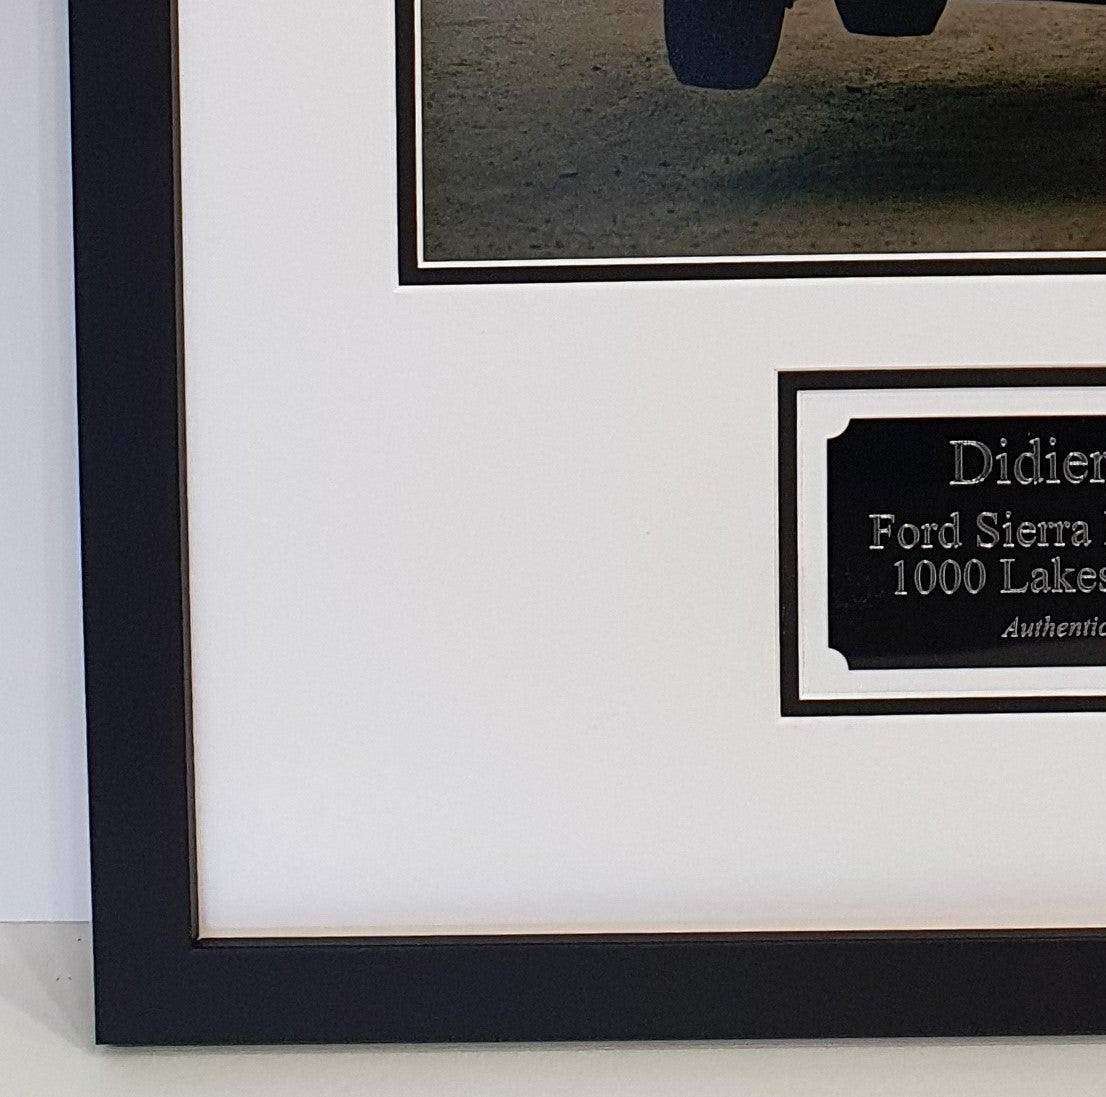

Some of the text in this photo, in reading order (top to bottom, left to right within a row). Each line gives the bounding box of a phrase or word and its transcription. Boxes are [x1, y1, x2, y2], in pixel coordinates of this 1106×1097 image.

[868, 512, 962, 550] Ford
[976, 511, 1093, 549] Sierra
[893, 559, 987, 596] 1000
